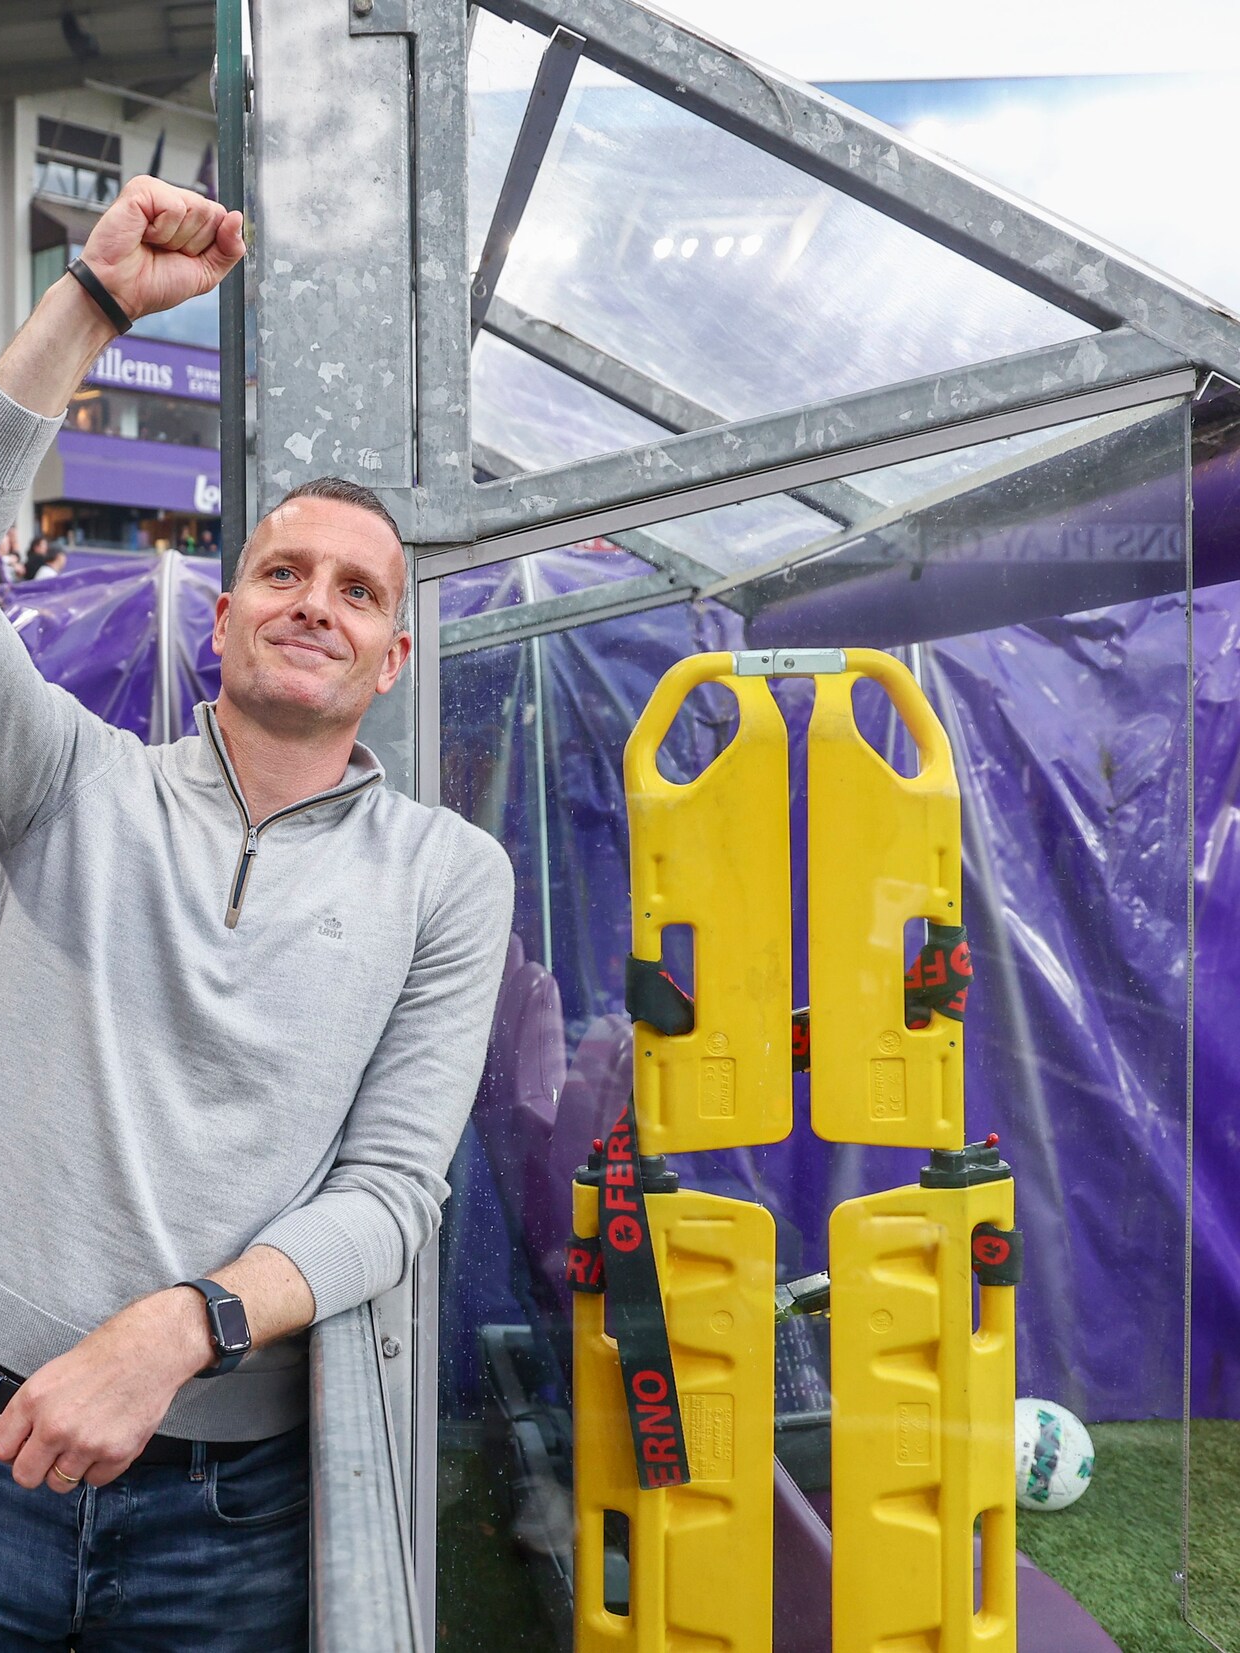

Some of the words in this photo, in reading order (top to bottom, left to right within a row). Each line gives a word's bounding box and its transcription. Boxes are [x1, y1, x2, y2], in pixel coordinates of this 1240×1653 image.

[90, 347, 173, 390] illems
[720, 1073, 729, 1115] FERNO
[875, 1062, 884, 1103] FERNO
[713, 1418, 722, 1459] FERNO
